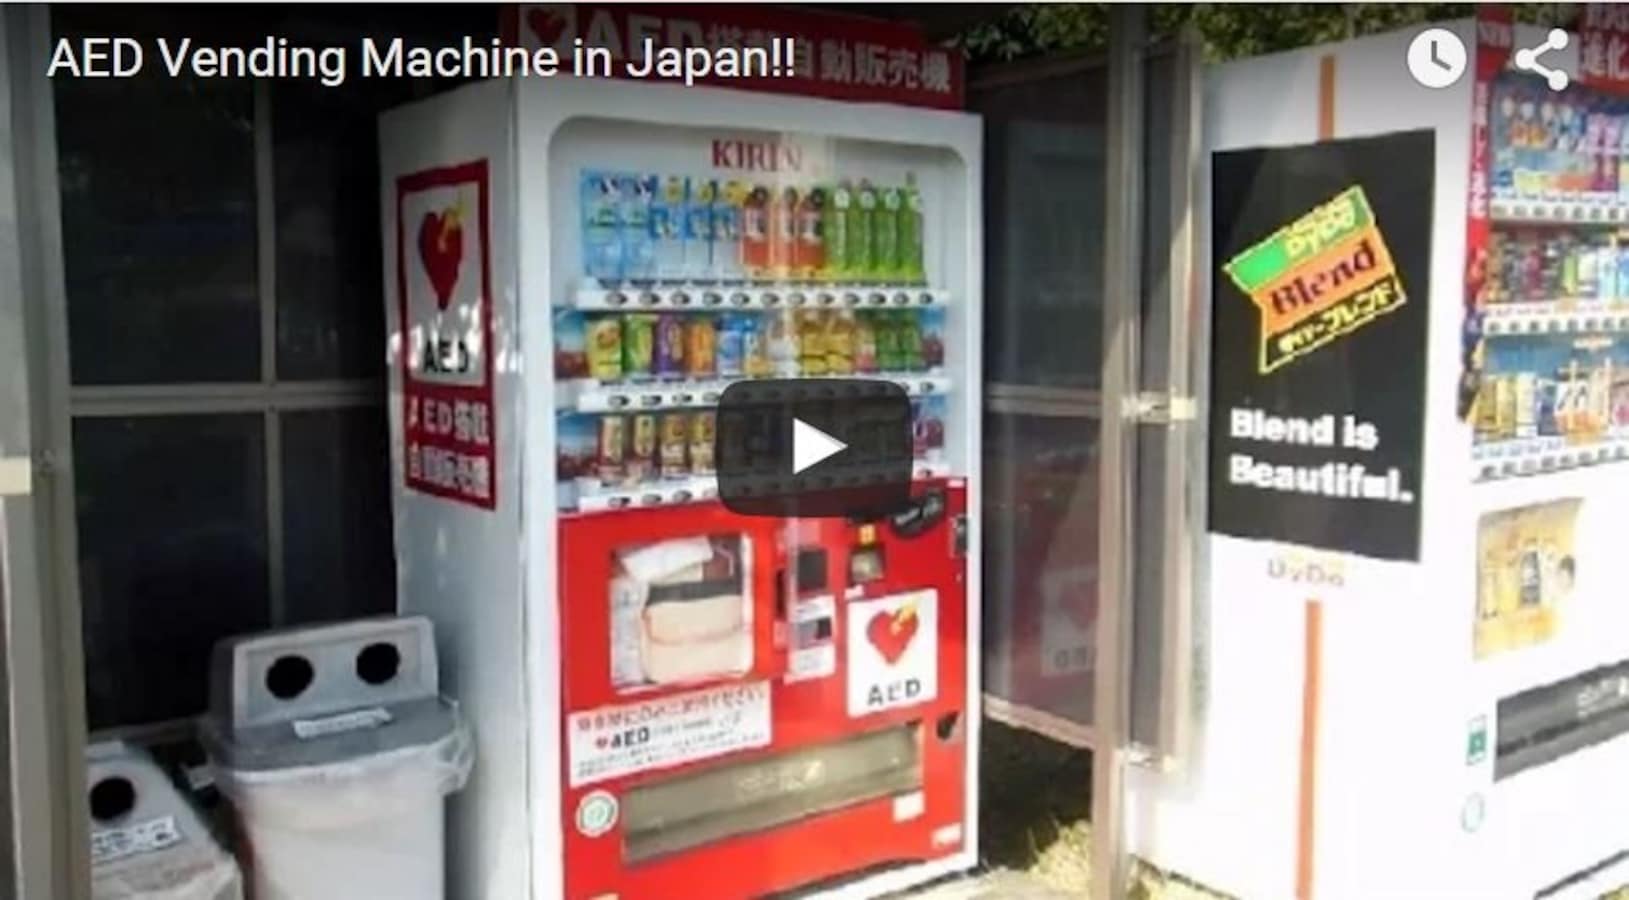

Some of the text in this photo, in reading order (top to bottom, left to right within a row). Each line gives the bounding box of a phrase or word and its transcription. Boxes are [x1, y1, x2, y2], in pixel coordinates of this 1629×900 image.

[712, 139, 803, 173] KIRIN
[1270, 239, 1376, 315] Blend
[423, 339, 470, 373] AED
[1229, 407, 1380, 451] Blend is
[1229, 453, 1415, 504] Beautiful.
[867, 679, 922, 706] AED
[610, 726, 651, 748] AED
